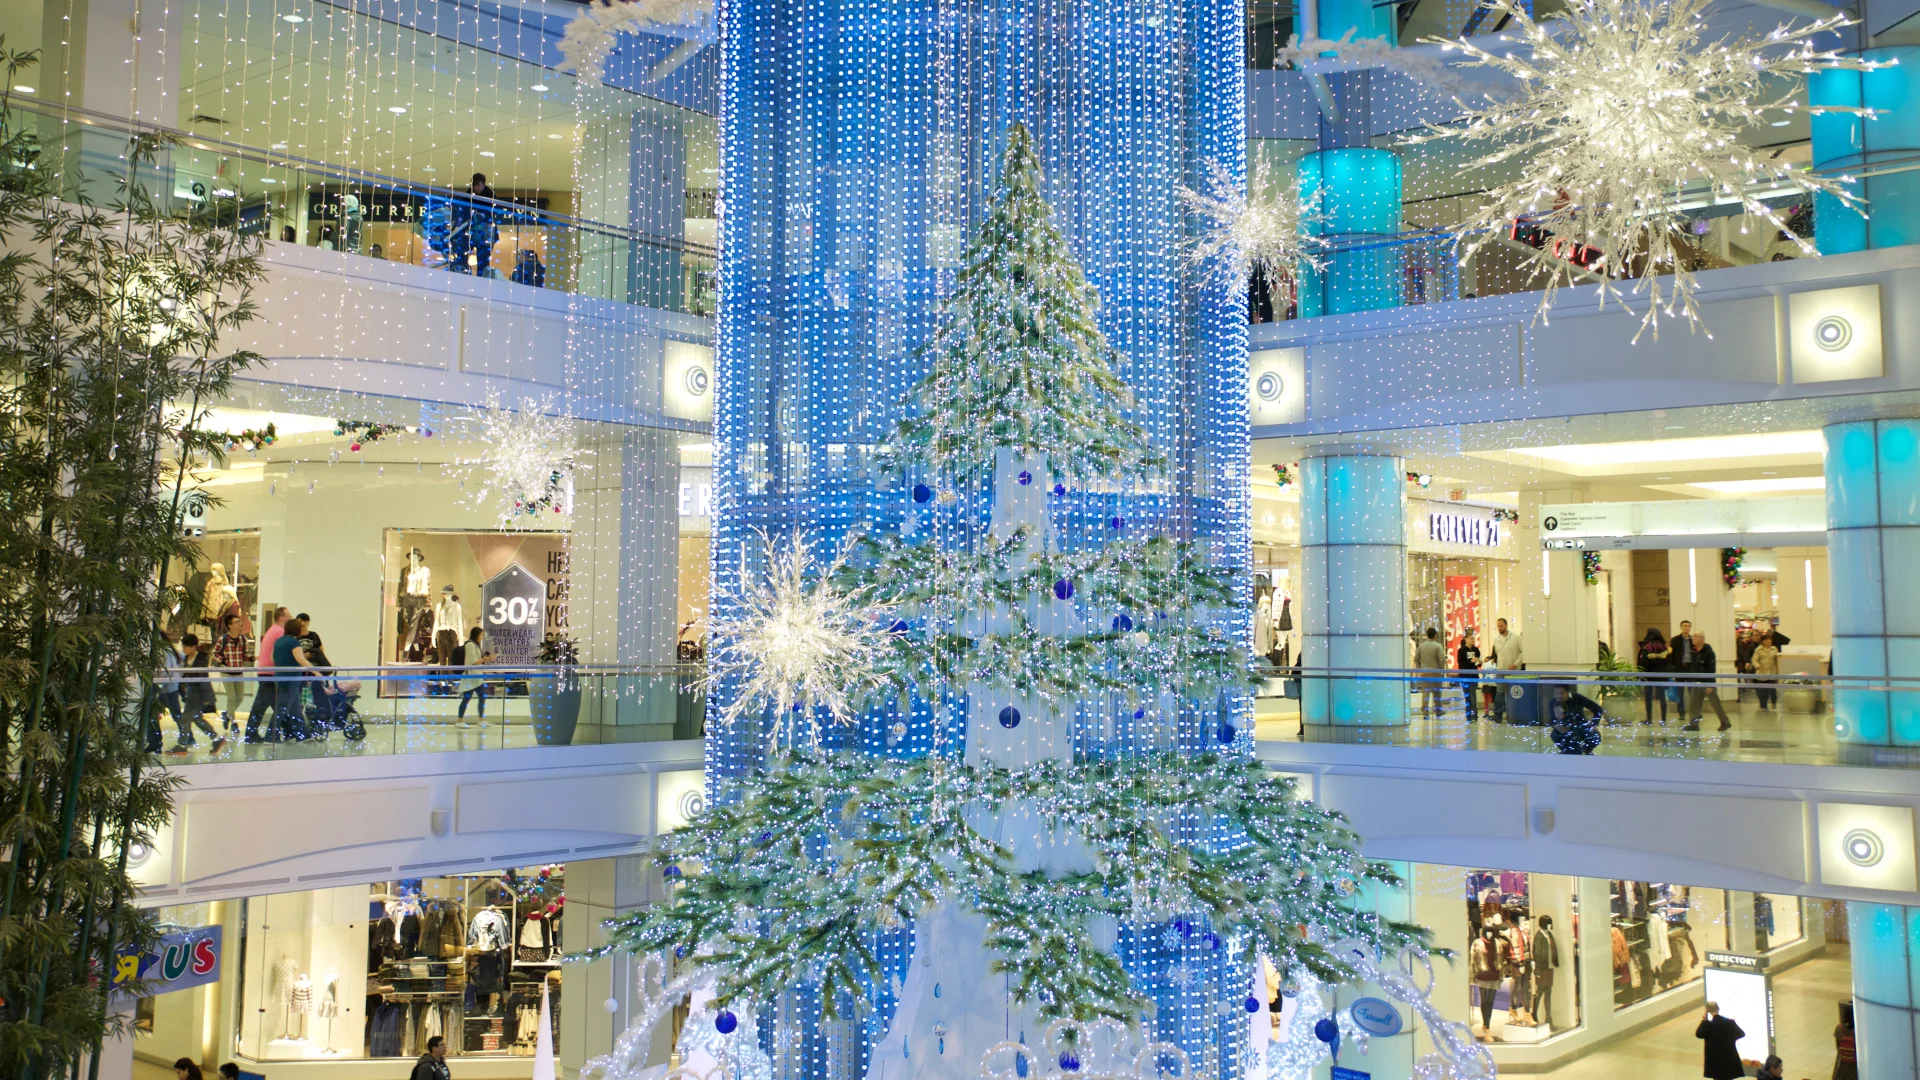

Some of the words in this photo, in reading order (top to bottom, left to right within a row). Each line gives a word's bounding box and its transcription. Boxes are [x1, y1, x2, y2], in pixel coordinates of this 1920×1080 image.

[313, 203, 428, 217] CRBTREE
[1444, 578, 1480, 615] SALE
[489, 597, 538, 625] 30%
[493, 638, 531, 647] SWEATERS
[502, 647, 529, 656] WINTER
[162, 937, 217, 981] US
[1709, 953, 1757, 965] DIRECTORY
